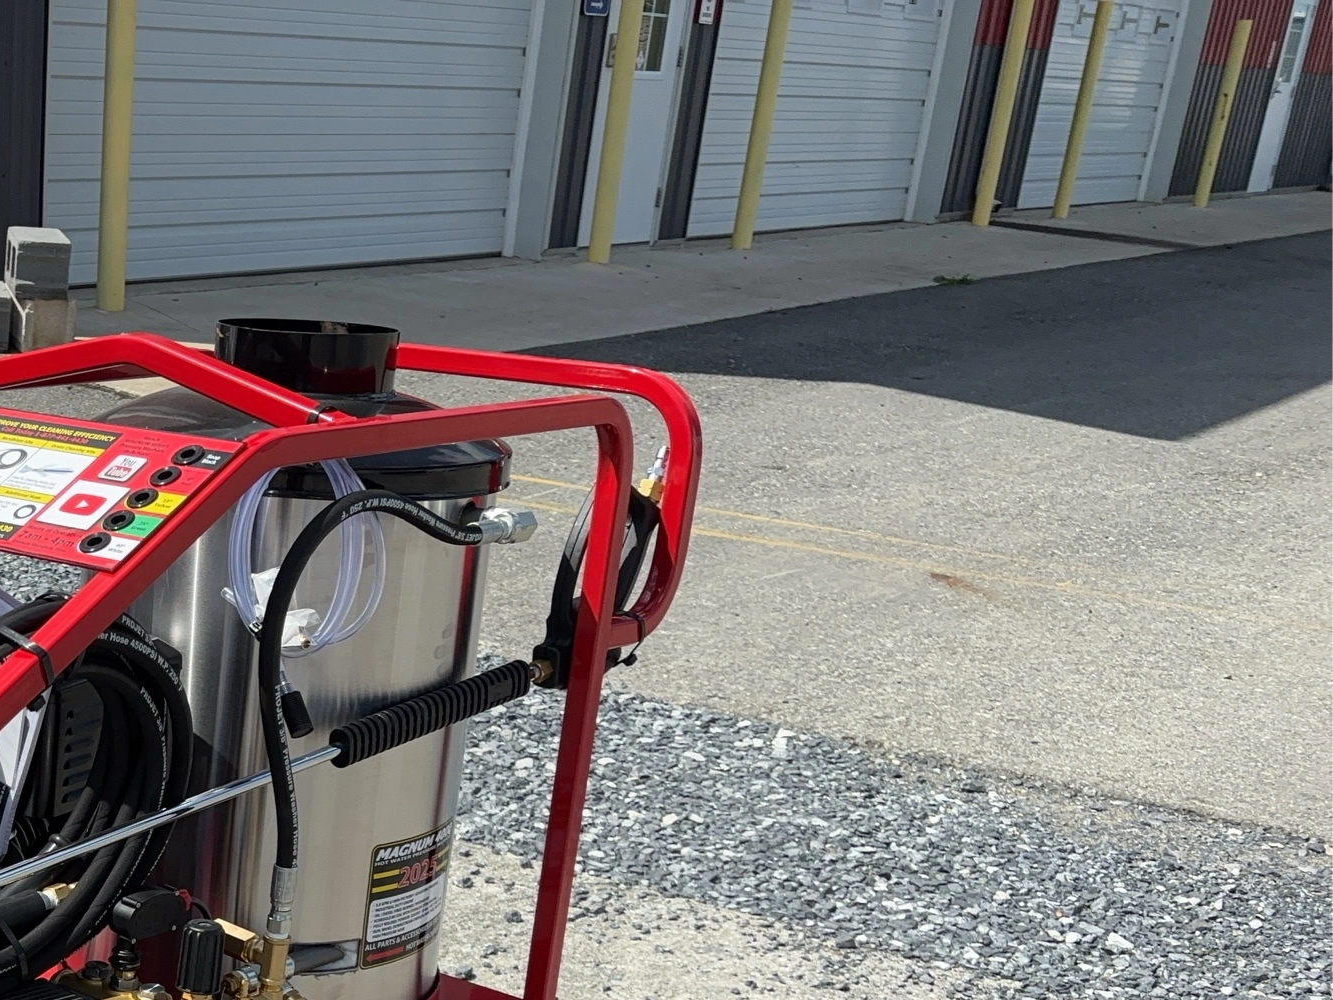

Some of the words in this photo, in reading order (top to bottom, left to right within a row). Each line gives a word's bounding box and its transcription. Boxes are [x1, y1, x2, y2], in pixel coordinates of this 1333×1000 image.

[14, 428, 34, 438] Today
[19, 422, 39, 431] YOUR
[39, 425, 73, 436] CLEANING
[72, 430, 116, 442] EFFICIENCY
[64, 445, 85, 454] Cleaning
[120, 457, 137, 468] You
[106, 466, 129, 478] Tube
[5, 489, 30, 499] Additional
[350, 501, 363, 514] 250
[365, 498, 379, 508] W.P.
[380, 498, 404, 509] 4500PSI
[405, 502, 419, 515] Hose
[418, 510, 436, 527] Washer
[436, 520, 456, 538] Pressure
[18, 530, 42, 541] 7am
[51, 537, 75, 549] 4pm
[121, 615, 145, 638] PROJET
[110, 632, 129, 645] Hose
[130, 639, 157, 660] 4500PSI
[282, 747, 294, 791] Pressure
[289, 792, 298, 828] Washer
[376, 833, 435, 862] MAGNUM
[390, 854, 411, 864] WATER
[412, 845, 437, 858] PRESSURE
[397, 854, 438, 889] 2025
[365, 943, 377, 951] ALL
[377, 938, 395, 948] PARTS
